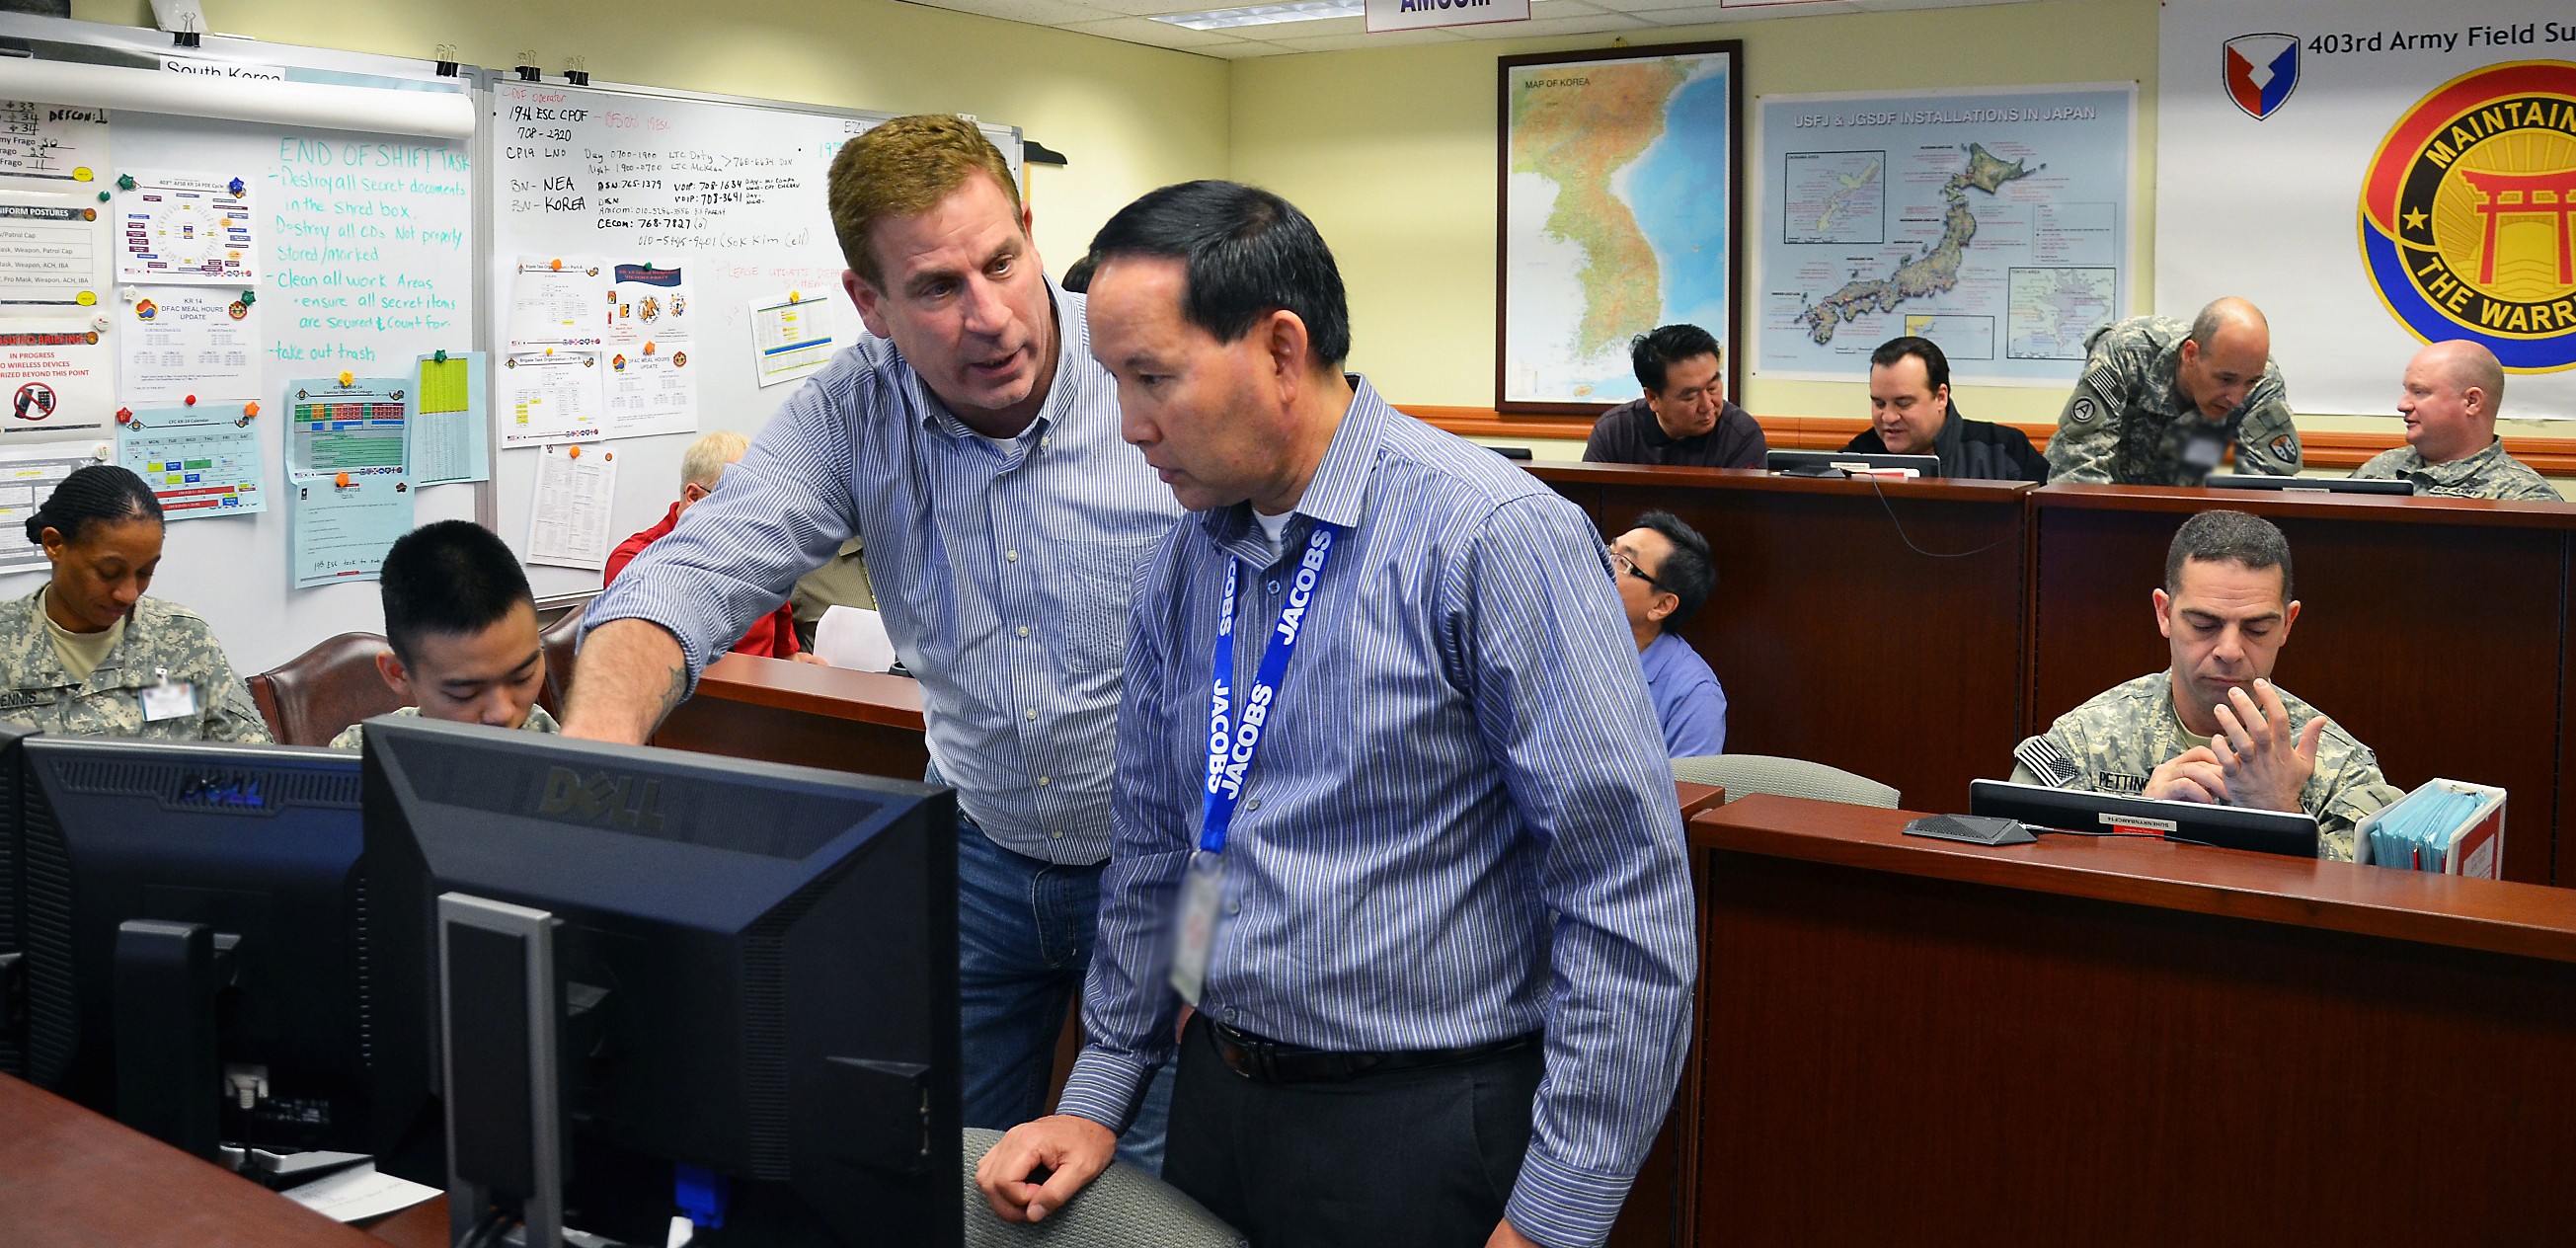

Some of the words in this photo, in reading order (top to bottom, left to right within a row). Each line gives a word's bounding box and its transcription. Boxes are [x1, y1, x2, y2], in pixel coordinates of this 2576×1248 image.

[1400, 0, 1491, 13] AMCO
[2308, 32, 2381, 53] 403rd
[2389, 31, 2459, 52] Army
[2468, 24, 2535, 46] Field
[1525, 80, 1544, 89] MAP
[1546, 79, 1558, 88] OF
[1560, 77, 1591, 87] KOREA
[536, 107, 556, 120] ESC
[560, 109, 589, 122] CPOF
[1794, 115, 1831, 128] USFJ
[1834, 114, 1843, 127] &
[1847, 112, 1897, 126] JGSDF
[1900, 108, 2020, 124] INSTALLATIONS
[2023, 108, 2040, 121] IN
[2043, 106, 2097, 120] JAPAN
[13, 136, 36, 146] Frago
[279, 136, 332, 167] END
[343, 143, 372, 167] OF
[375, 144, 430, 174] SHIFT
[585, 147, 604, 164] Day
[336, 174, 356, 190] all
[543, 176, 575, 192] NEA
[30, 208, 69, 217] POSTURES
[285, 197, 300, 212] in
[304, 197, 325, 212] the
[545, 195, 586, 213] KOREA
[339, 222, 355, 238] all
[277, 268, 318, 289] Clean
[323, 270, 343, 286] all
[346, 273, 388, 288] work
[397, 273, 433, 290] Areas
[301, 296, 348, 308] ensure
[357, 292, 375, 308] all
[2417, 256, 2474, 314] THE
[2480, 295, 2576, 332] WARR
[299, 317, 321, 329] are
[309, 343, 333, 360] out
[338, 343, 375, 361] trash
[1277, 528, 1332, 646] JACOBS
[1219, 557, 1237, 637] COBS
[1208, 678, 1229, 794] JACOBS
[1220, 680, 1273, 800] JACOBS
[539, 765, 664, 831] DELL
